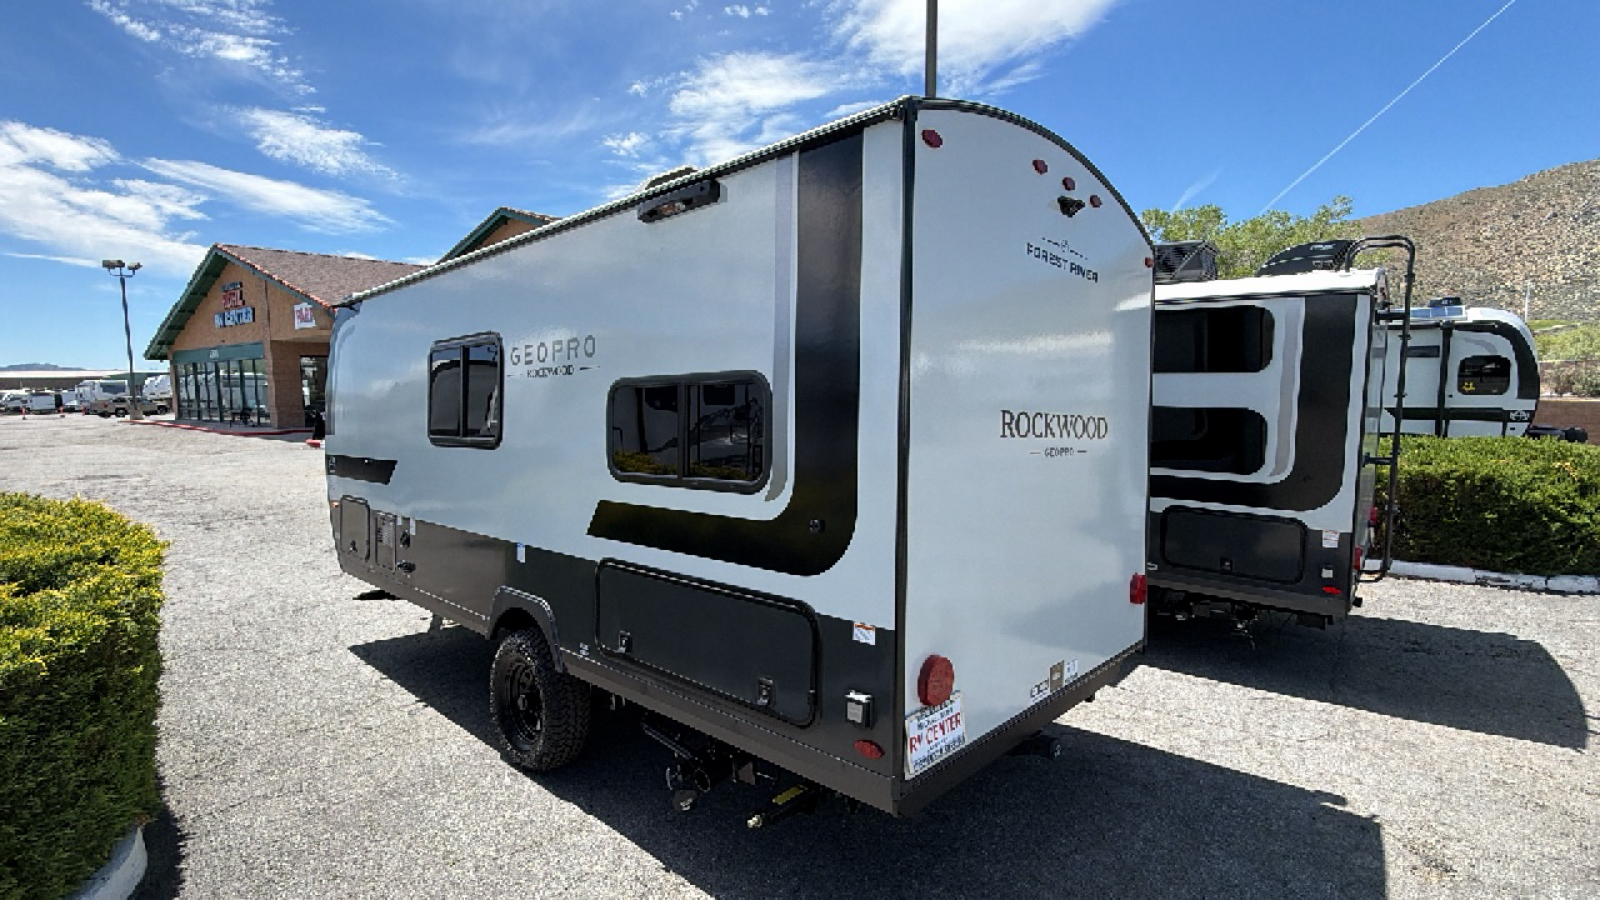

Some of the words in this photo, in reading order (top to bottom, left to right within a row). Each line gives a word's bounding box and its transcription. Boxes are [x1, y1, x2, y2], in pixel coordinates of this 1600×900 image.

[1026, 242, 1068, 270] FOREST
[1069, 262, 1098, 283] RIVER
[510, 335, 596, 366] GEOPRO
[527, 364, 574, 378] ROCKWOOD
[1000, 409, 1108, 440] ROCKWOOD
[1044, 447, 1075, 458] GEOPRO
[909, 731, 923, 755] RV
[925, 711, 961, 745] CENTER
